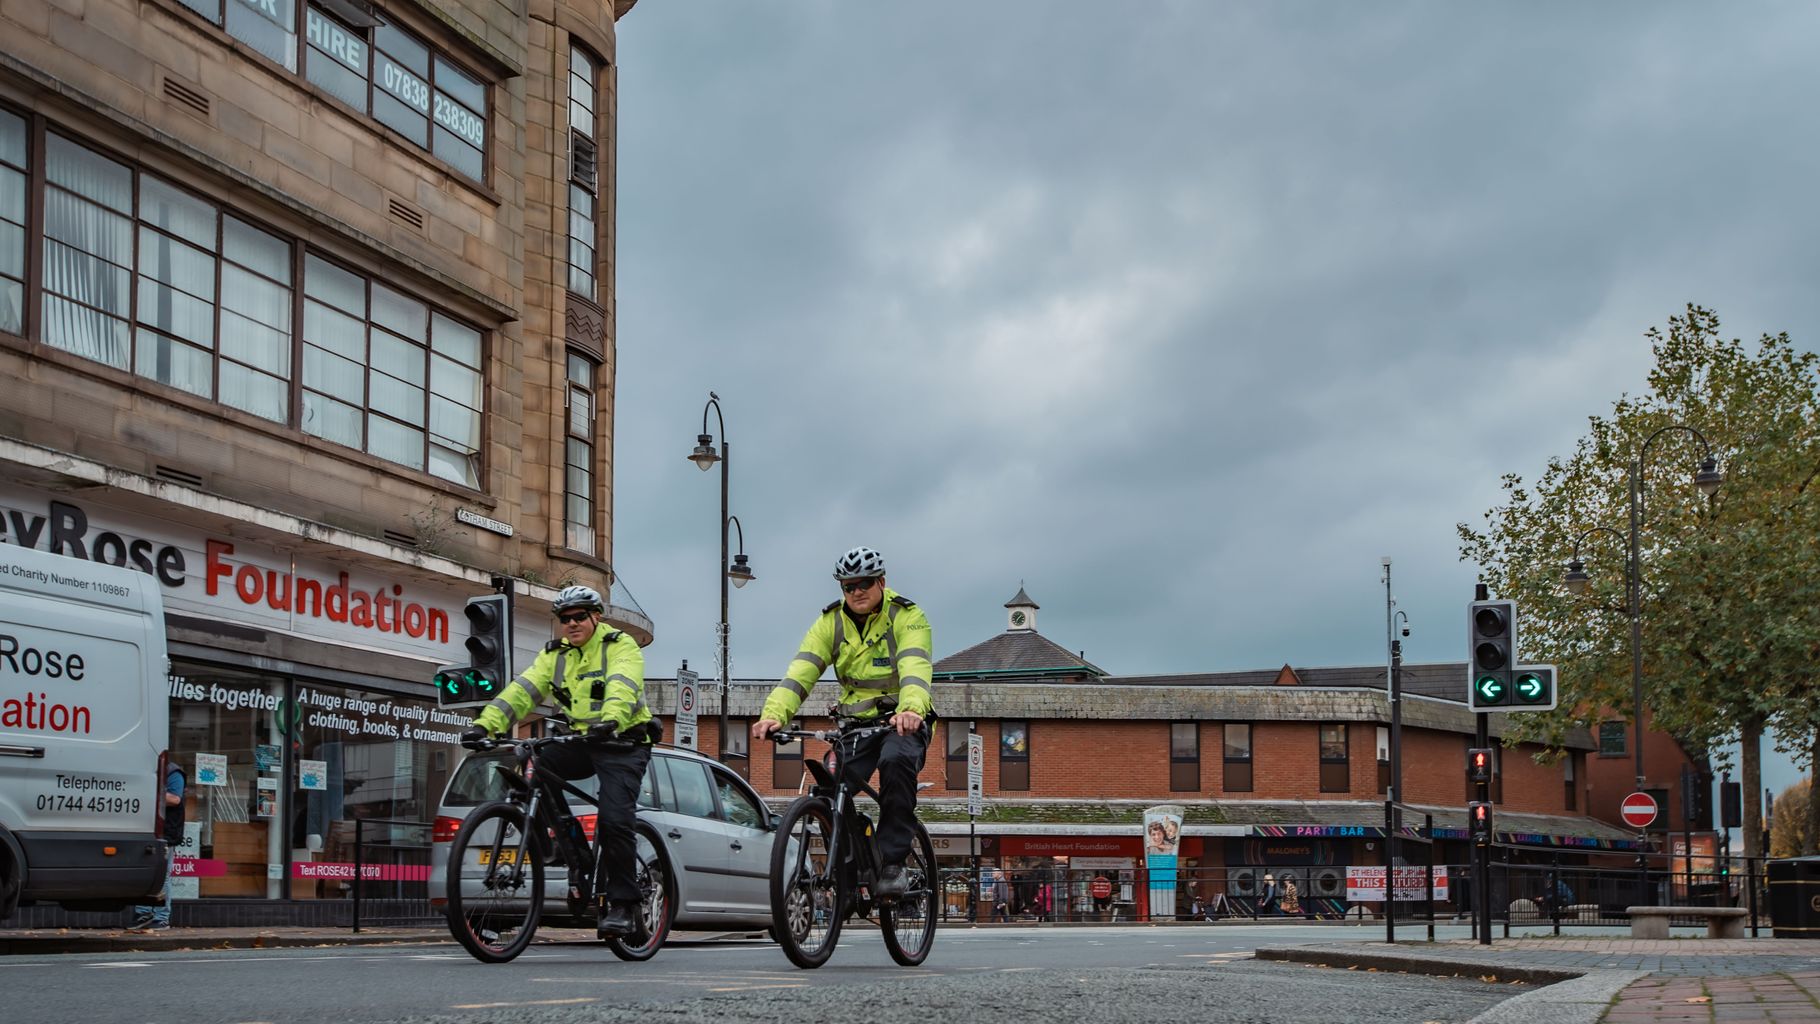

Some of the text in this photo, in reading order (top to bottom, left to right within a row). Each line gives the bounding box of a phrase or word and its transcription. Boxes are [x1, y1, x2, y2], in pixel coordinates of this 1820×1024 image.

[306, 10, 360, 68] HIRE
[384, 63, 484, 145] 07838 238309
[489, 520, 511, 535] STREET
[12, 564, 49, 584] Charity
[51, 572, 90, 590] Number
[92, 581, 131, 598] 1109867
[205, 538, 449, 643] Foundation
[0, 634, 85, 681] Rose
[210, 682, 283, 711] together
[297, 687, 308, 703] A
[311, 689, 341, 711] huge
[343, 697, 377, 716] range
[378, 701, 391, 716] of
[392, 705, 430, 724] quality
[1, 692, 91, 734] ation
[308, 712, 360, 735] clothing,
[362, 718, 400, 739] books,
[402, 725, 411, 738] &
[56, 774, 126, 792] Telephone:
[36, 794, 140, 813] 01744 451919
[1296, 826, 1364, 836] PARTY BAR
[1024, 842, 1120, 851] British Heart Foundation
[300, 864, 316, 876] Text
[317, 865, 349, 877] ROSE42
[1356, 878, 1379, 887] THIS
